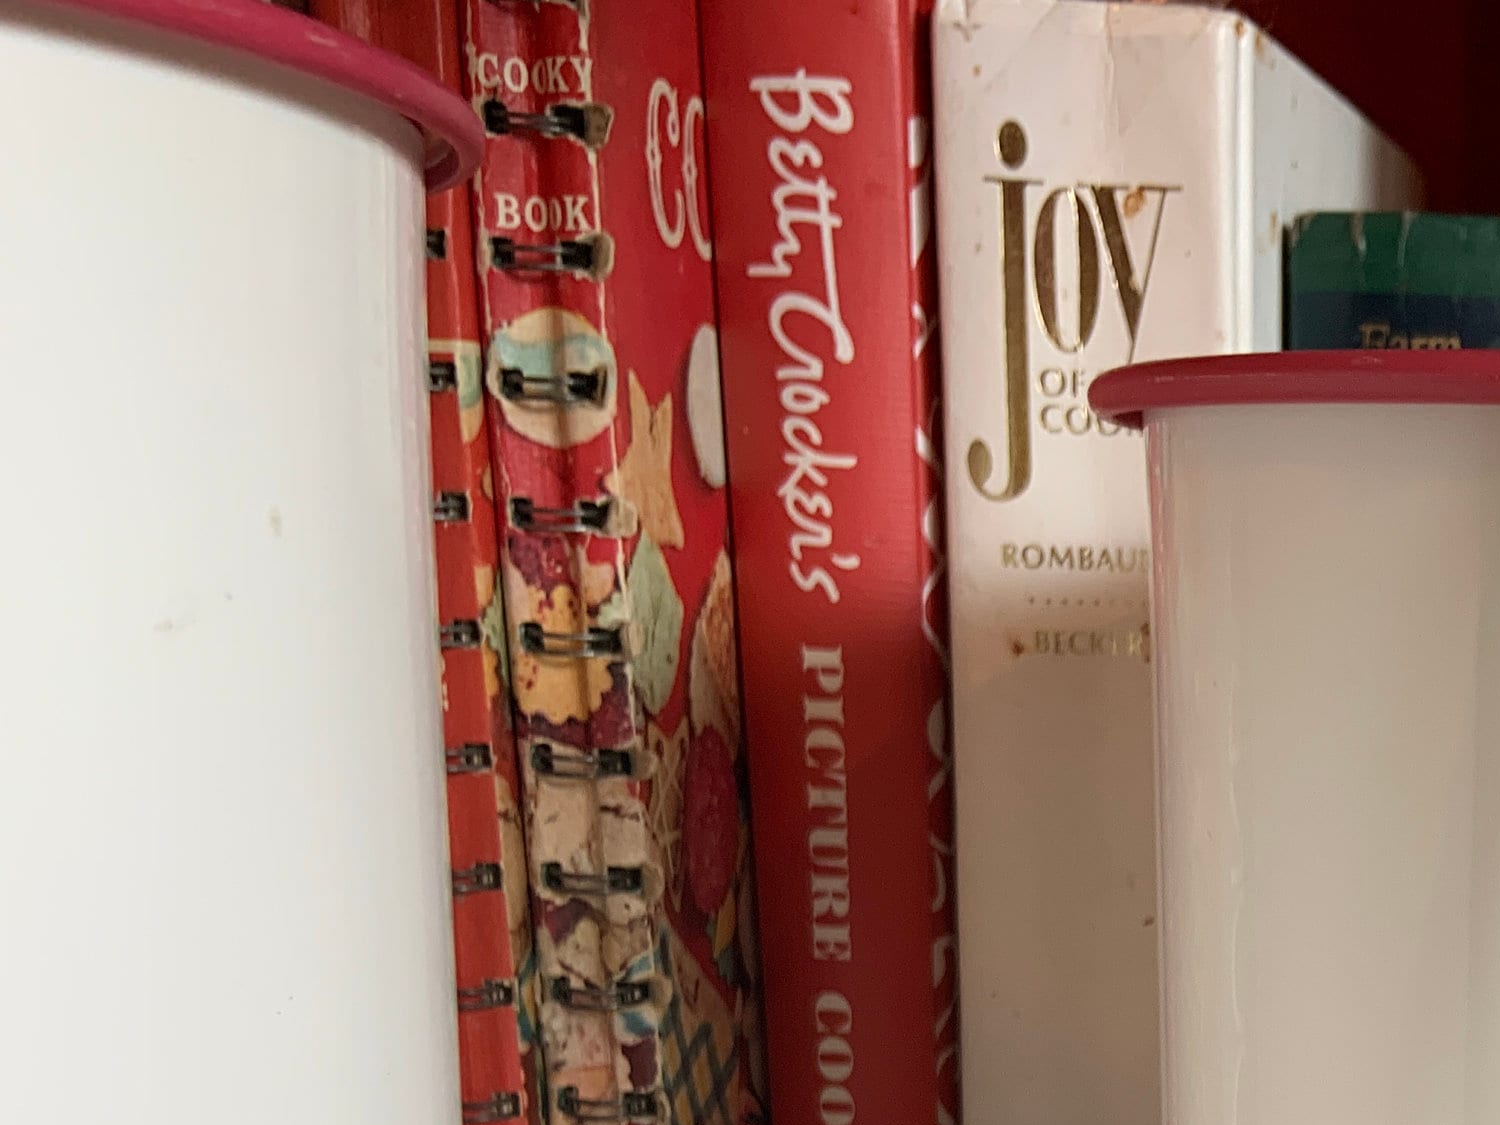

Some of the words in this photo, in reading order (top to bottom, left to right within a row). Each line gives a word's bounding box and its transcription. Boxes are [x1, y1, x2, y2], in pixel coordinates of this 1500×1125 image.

[477, 52, 592, 93] COOKY
[494, 192, 590, 232] BOOK
[747, 68, 855, 278] Betty
[967, 118, 1183, 501] joy
[1038, 368, 1086, 398] OF
[769, 290, 861, 604] Crocker's
[1034, 630, 1143, 657] BECKER
[802, 645, 852, 961] PICTURE
